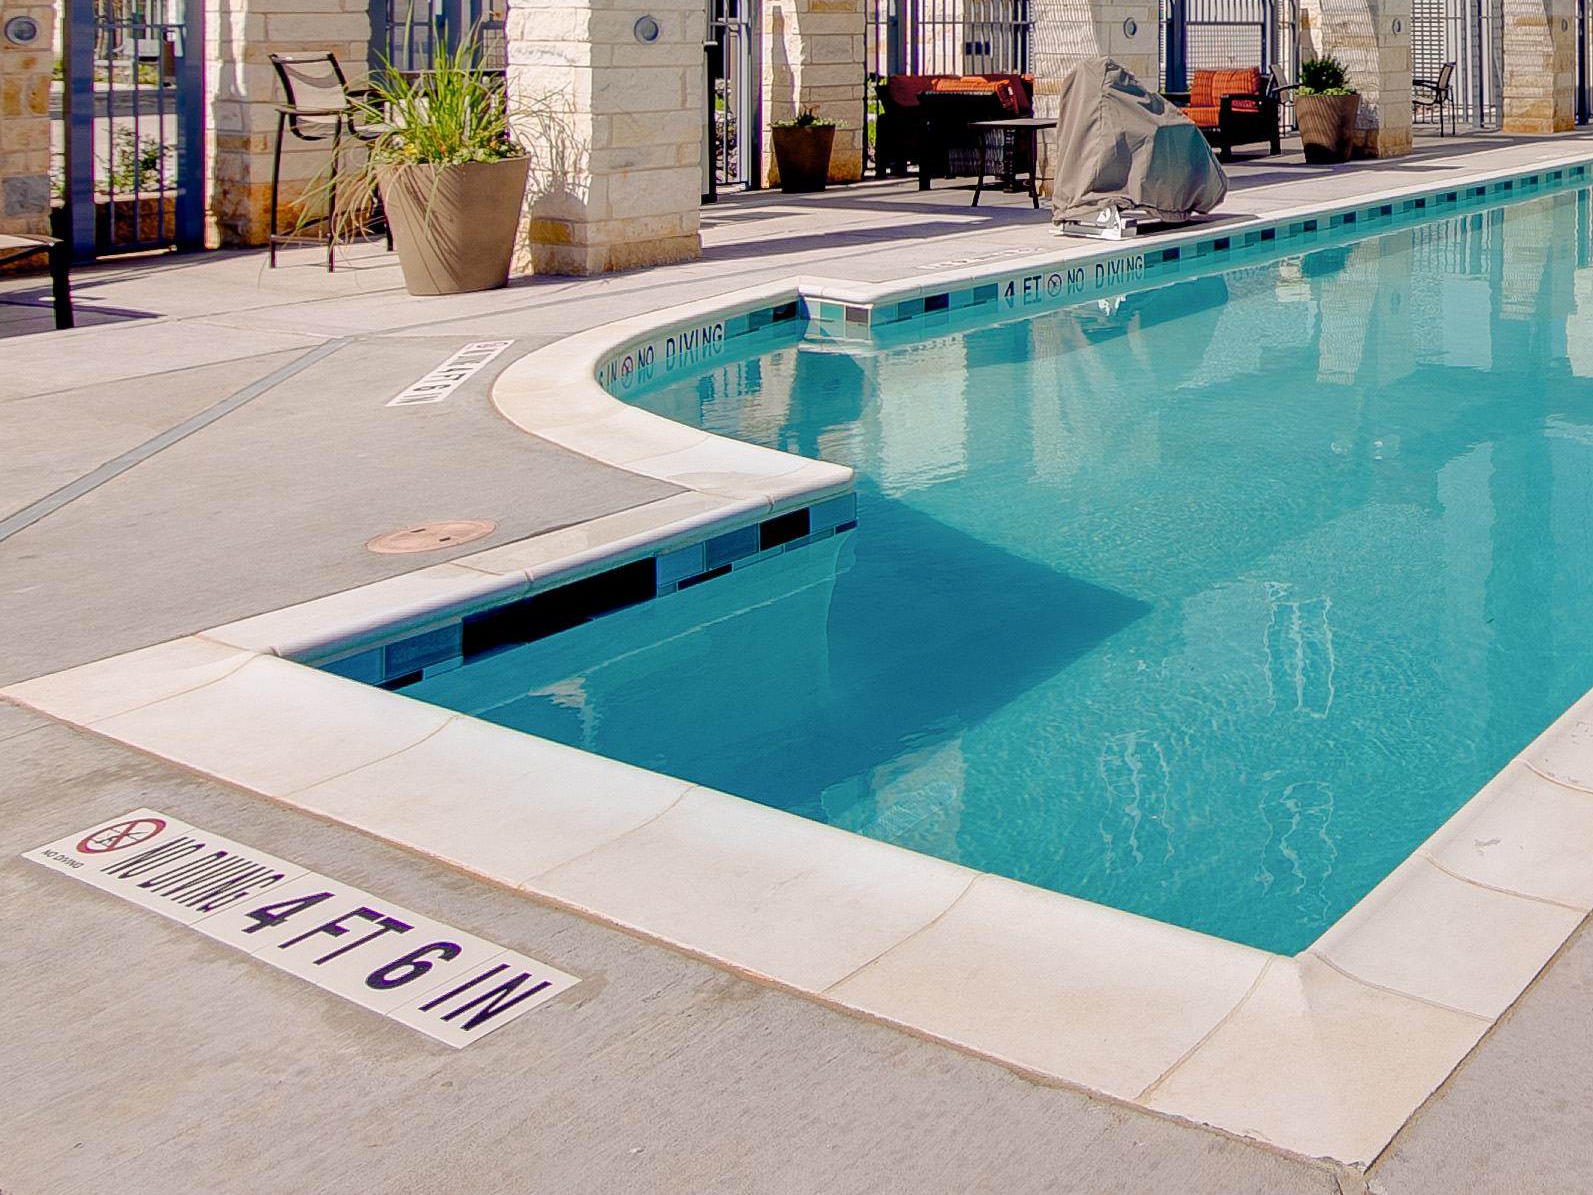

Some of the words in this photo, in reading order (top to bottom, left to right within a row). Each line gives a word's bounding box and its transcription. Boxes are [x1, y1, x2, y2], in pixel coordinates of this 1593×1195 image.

[1067, 268, 1085, 285] NO
[1095, 256, 1143, 279] DIVING
[638, 346, 654, 370] NO
[666, 323, 723, 358] DIVING
[100, 836, 205, 879] NO
[136, 851, 284, 913] DIVING
[241, 892, 335, 934] 4
[277, 907, 414, 965] FT
[365, 941, 462, 990] 6
[418, 963, 553, 1032] IN
